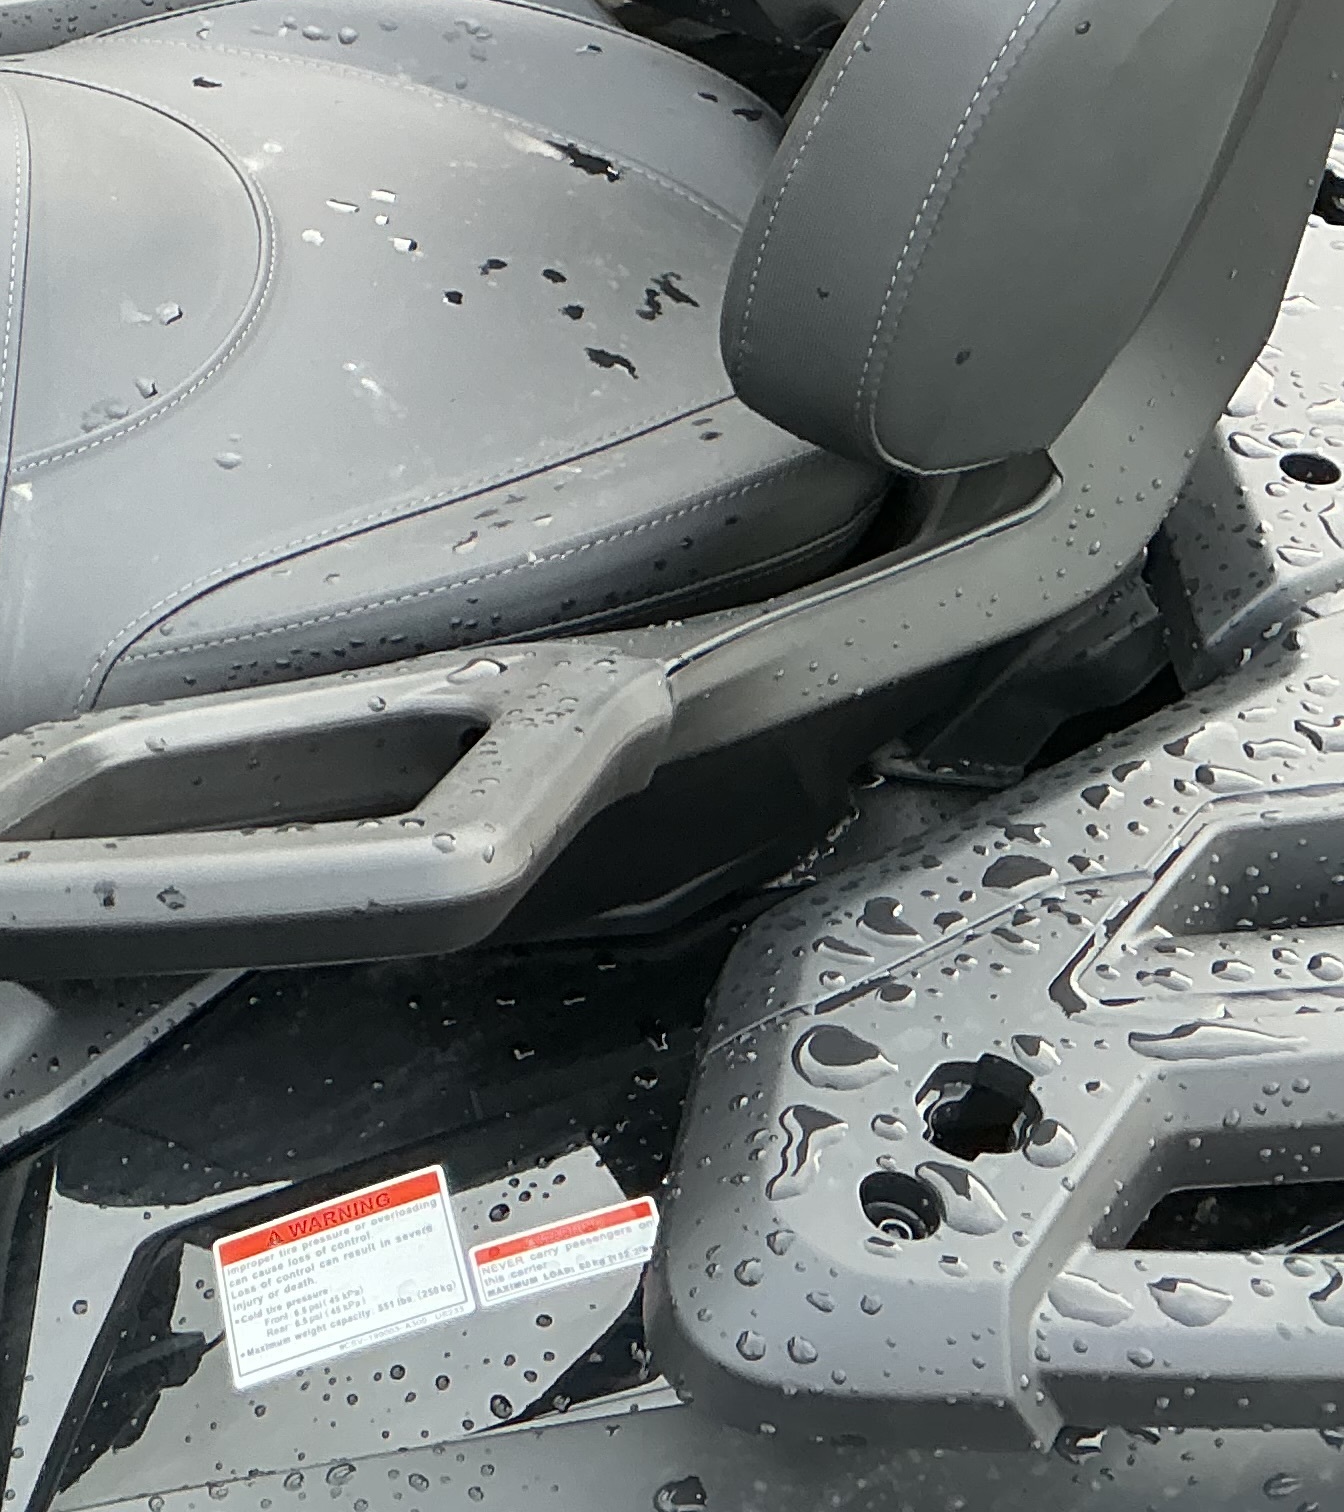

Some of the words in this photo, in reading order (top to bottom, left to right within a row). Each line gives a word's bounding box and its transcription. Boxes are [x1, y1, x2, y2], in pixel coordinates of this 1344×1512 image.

[227, 1254, 274, 1276] Improper
[279, 1245, 296, 1257] tire
[302, 1228, 349, 1250] pressure
[355, 1222, 365, 1230] or
[370, 1197, 436, 1228] overloading
[287, 1191, 391, 1238] WARNING
[231, 1284, 256, 1299] Loss
[260, 1278, 271, 1288] of
[276, 1263, 314, 1283] control
[319, 1256, 338, 1268] can
[343, 1242, 375, 1260] result
[380, 1237, 390, 1247] in
[395, 1224, 432, 1242] severe
